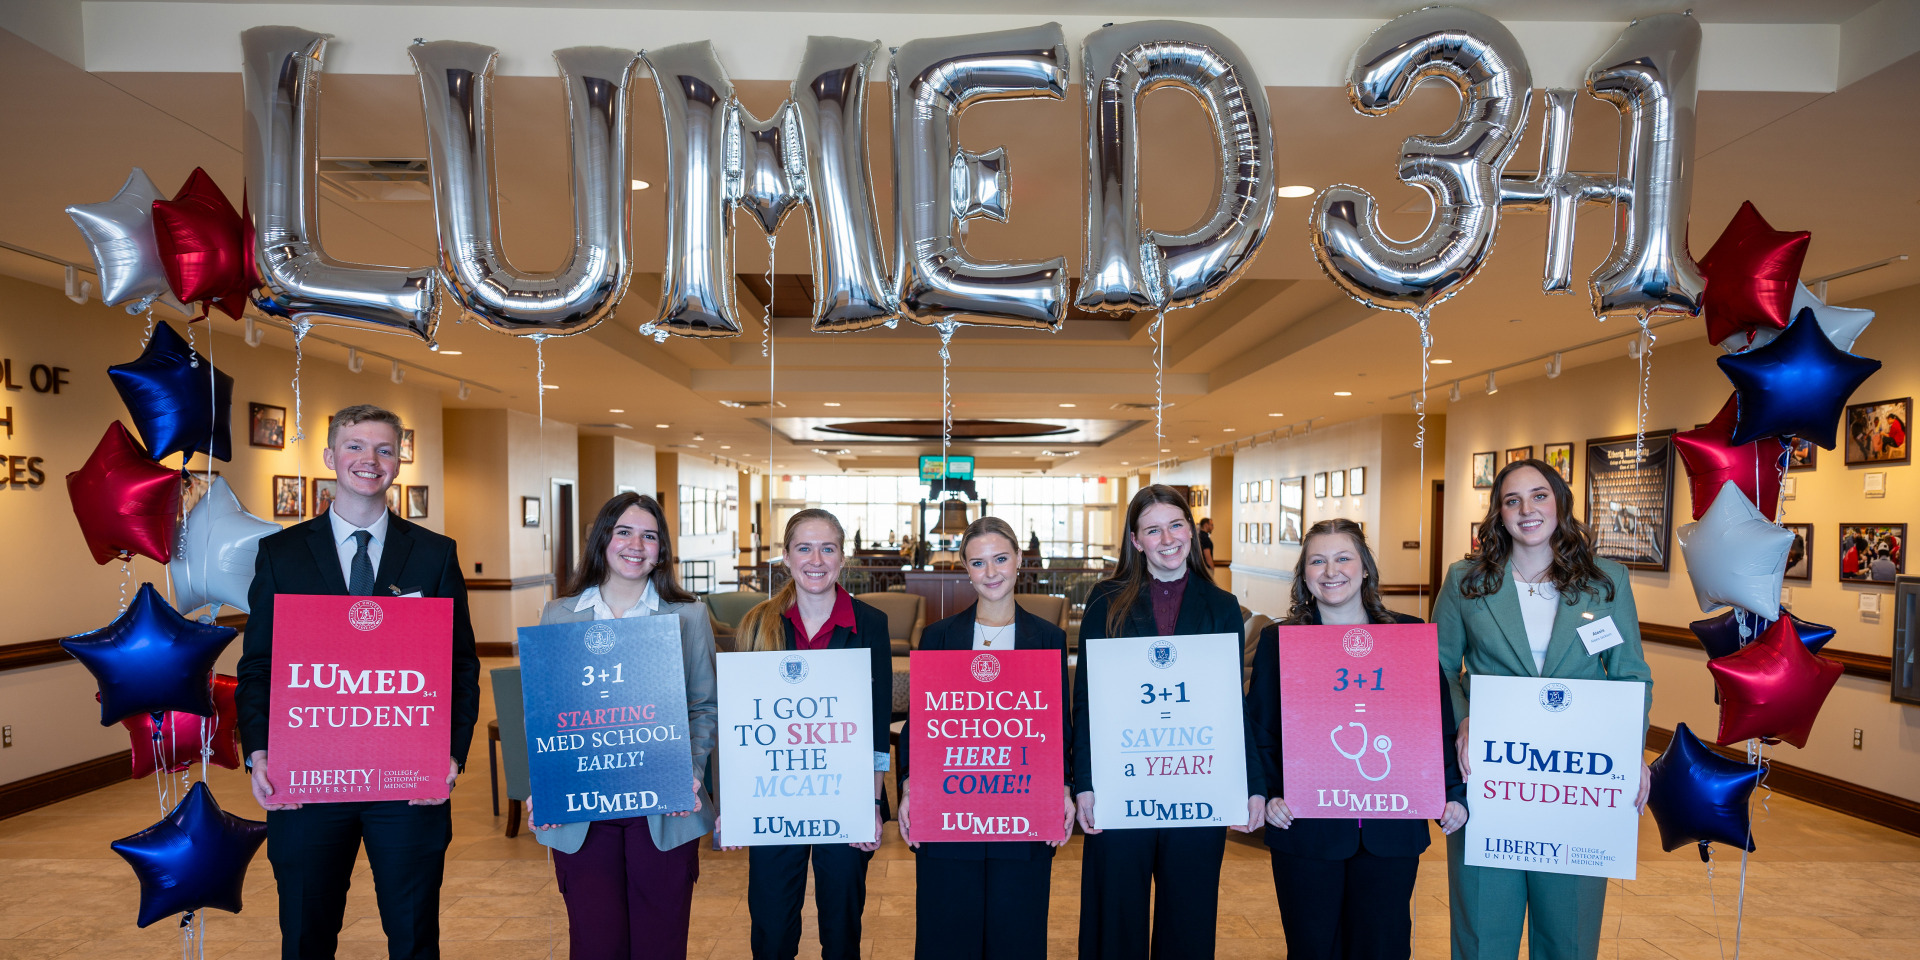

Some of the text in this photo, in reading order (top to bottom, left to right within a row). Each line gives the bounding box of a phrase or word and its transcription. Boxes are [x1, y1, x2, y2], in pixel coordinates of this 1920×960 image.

[241, 20, 1274, 345] LUMED
[30, 364, 70, 395] OF
[287, 663, 438, 698] LUMED 3+1
[581, 662, 625, 687] 3+1
[1333, 667, 1385, 692] 3+1
[599, 690, 610, 699] =
[924, 690, 1049, 711] MEDICAL
[1140, 681, 1191, 705] 3+1
[288, 705, 435, 729] STUDENT
[557, 703, 657, 729] STARTING
[753, 696, 838, 721] I GOT
[1160, 711, 1171, 719] =
[1354, 703, 1366, 713] =
[536, 724, 682, 754] MED SCHOOL
[734, 721, 858, 747] TO SKIP
[926, 718, 1047, 743] SCHOOL,
[1120, 725, 1214, 749] SAVING
[576, 750, 645, 773] EARLY!
[765, 748, 828, 772] THE
[943, 746, 1029, 767] HERE I
[1124, 754, 1213, 777] a YEAR!
[1482, 739, 1626, 781] LUMED 3+1
[289, 768, 375, 787] LIBERTY
[383, 769, 420, 777] COLLEGE of
[383, 775, 430, 783] OSTEOPATHIC
[942, 774, 1032, 795] COME!!
[289, 786, 372, 795] UNIVERSITY
[383, 782, 418, 790] MEDICINE
[752, 773, 843, 798] MCAT!
[1483, 779, 1623, 809] STUDENT
[565, 790, 659, 814] LUMED
[1124, 799, 1214, 821] LUMED
[1316, 789, 1410, 812] LUMED
[752, 816, 841, 839] LUMED
[941, 812, 1030, 836] LUMED
[1484, 837, 1563, 858] LIBERTY
[1484, 852, 1560, 865] UNIVERSITY
[1571, 846, 1600, 855] COLLEGE
[1571, 852, 1616, 862] OSTEOPATHIC
[1571, 859, 1604, 867] MEDICINE
